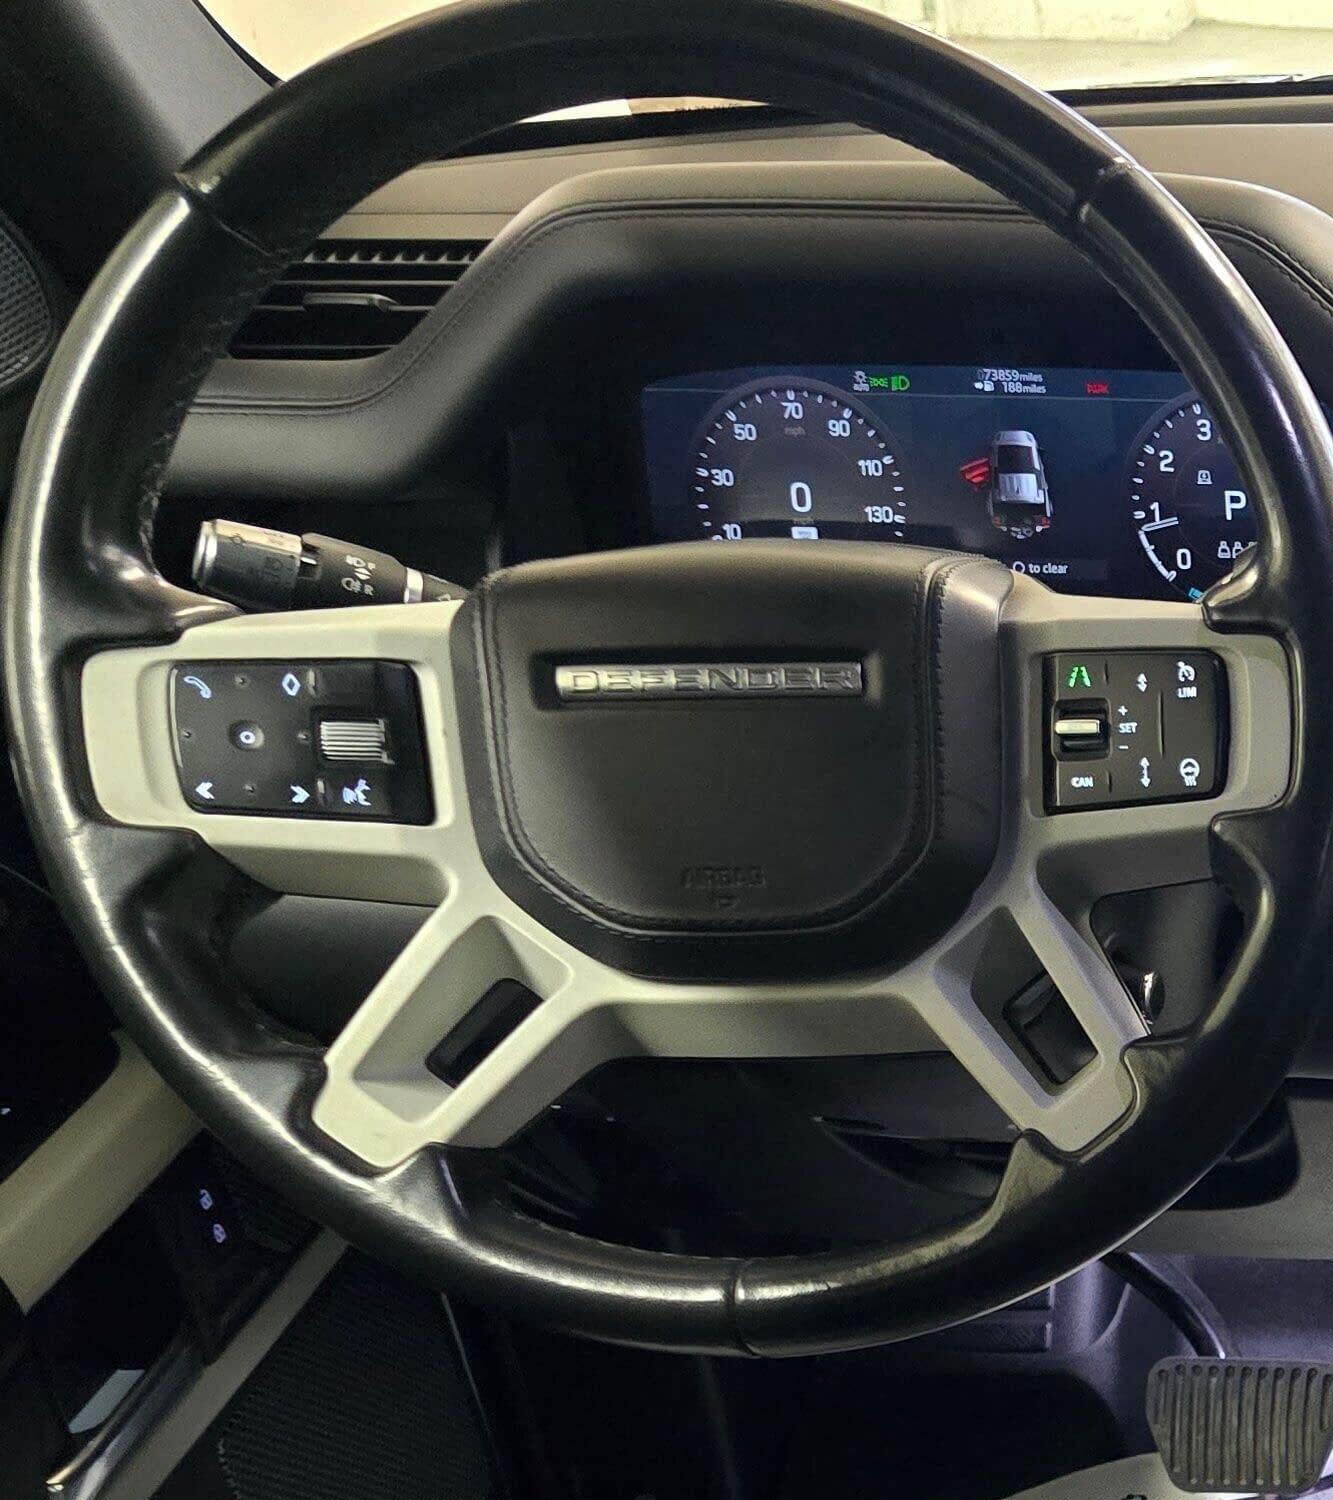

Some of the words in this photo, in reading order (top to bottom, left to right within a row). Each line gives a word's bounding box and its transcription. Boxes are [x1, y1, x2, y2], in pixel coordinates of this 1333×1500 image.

[781, 402, 804, 419] 70
[734, 424, 757, 441] 50
[828, 420, 851, 437] 90
[1197, 419, 1211, 441] 3
[858, 459, 883, 476] 110
[1159, 451, 1174, 472] 2
[711, 469, 734, 486] 30
[790, 482, 812, 512] 0
[1224, 490, 1247, 520] P
[864, 506, 893, 523] 130
[1150, 502, 1161, 524] 1
[723, 524, 742, 540] 10
[1176, 548, 1192, 570] 0
[1028, 564, 1041, 574] to
[1042, 562, 1068, 574] clear
[568, 666, 854, 694] DEFENDER
[1177, 686, 1198, 698] LIM
[1118, 722, 1138, 734] SET
[1070, 776, 1094, 788] CAN
